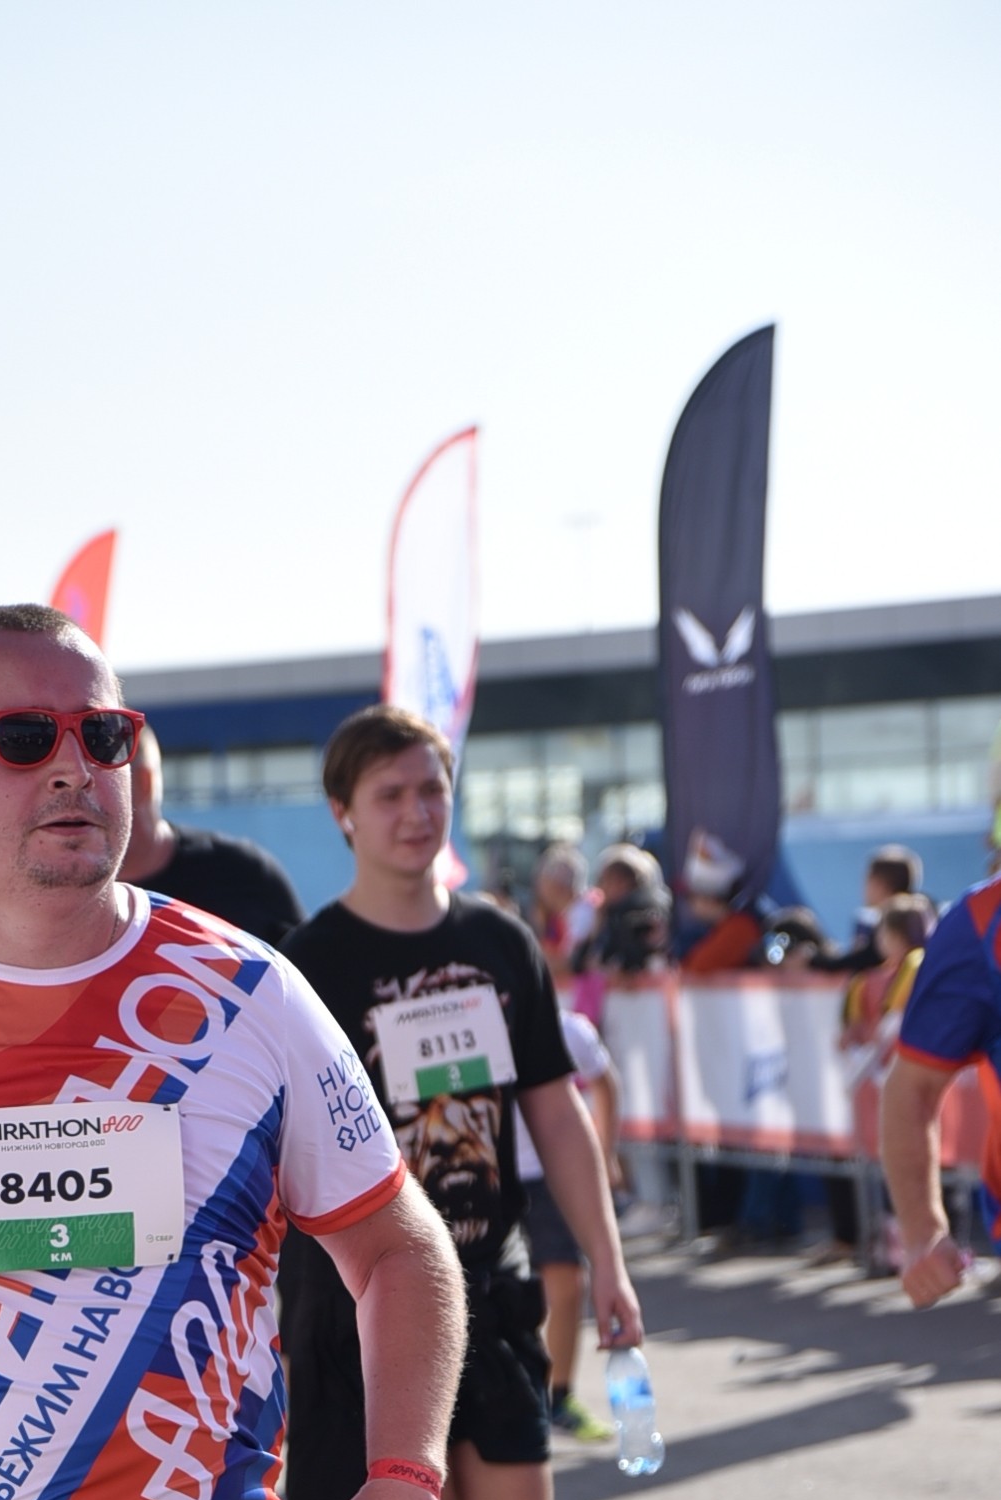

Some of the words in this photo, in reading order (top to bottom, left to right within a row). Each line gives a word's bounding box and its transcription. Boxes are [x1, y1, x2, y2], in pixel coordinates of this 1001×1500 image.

[418, 1029, 476, 1057] 8113
[1, 1142, 43, 1152] НИЖНИЙ
[44, 1140, 89, 1150] НОВГОРОД
[0, 1166, 113, 1205] 8405
[49, 1223, 70, 1248] 3
[155, 1234, 174, 1242] СБЕР
[63, 1306, 121, 1361] НА
